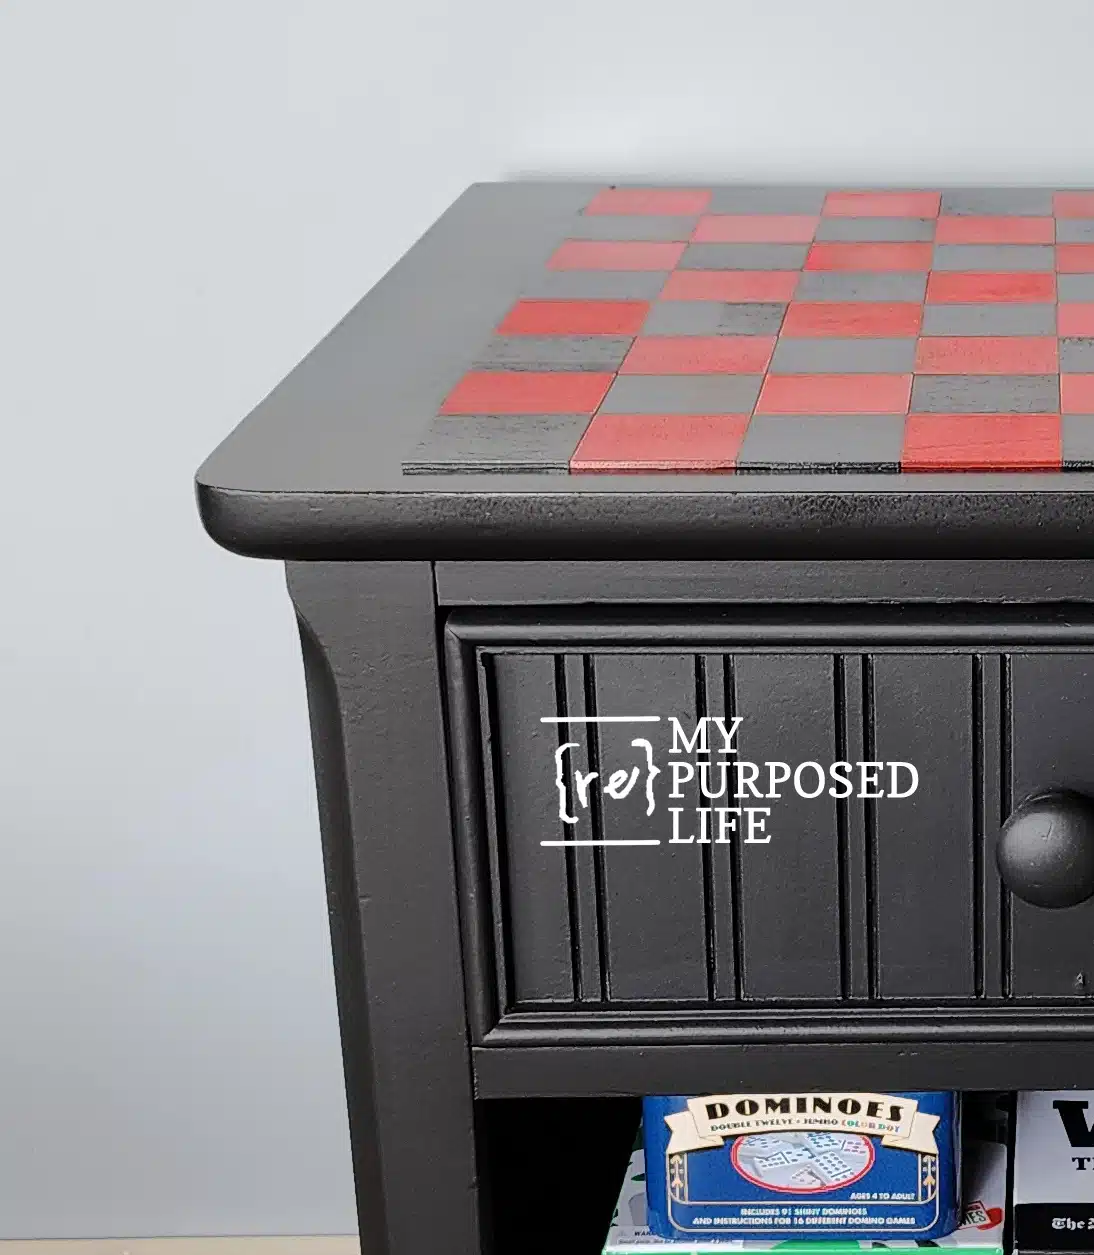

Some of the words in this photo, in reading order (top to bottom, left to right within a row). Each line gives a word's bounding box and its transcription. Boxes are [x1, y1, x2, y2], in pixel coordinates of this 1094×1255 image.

[705, 1096, 905, 1122] DOMINOES
[711, 1120, 752, 1132] DOUBLE
[756, 1118, 792, 1127] TWELVE
[804, 1118, 838, 1126] JUMBO
[841, 1119, 876, 1129] COLOR
[878, 1123, 900, 1133] DOT
[1051, 1217, 1085, 1230] The
